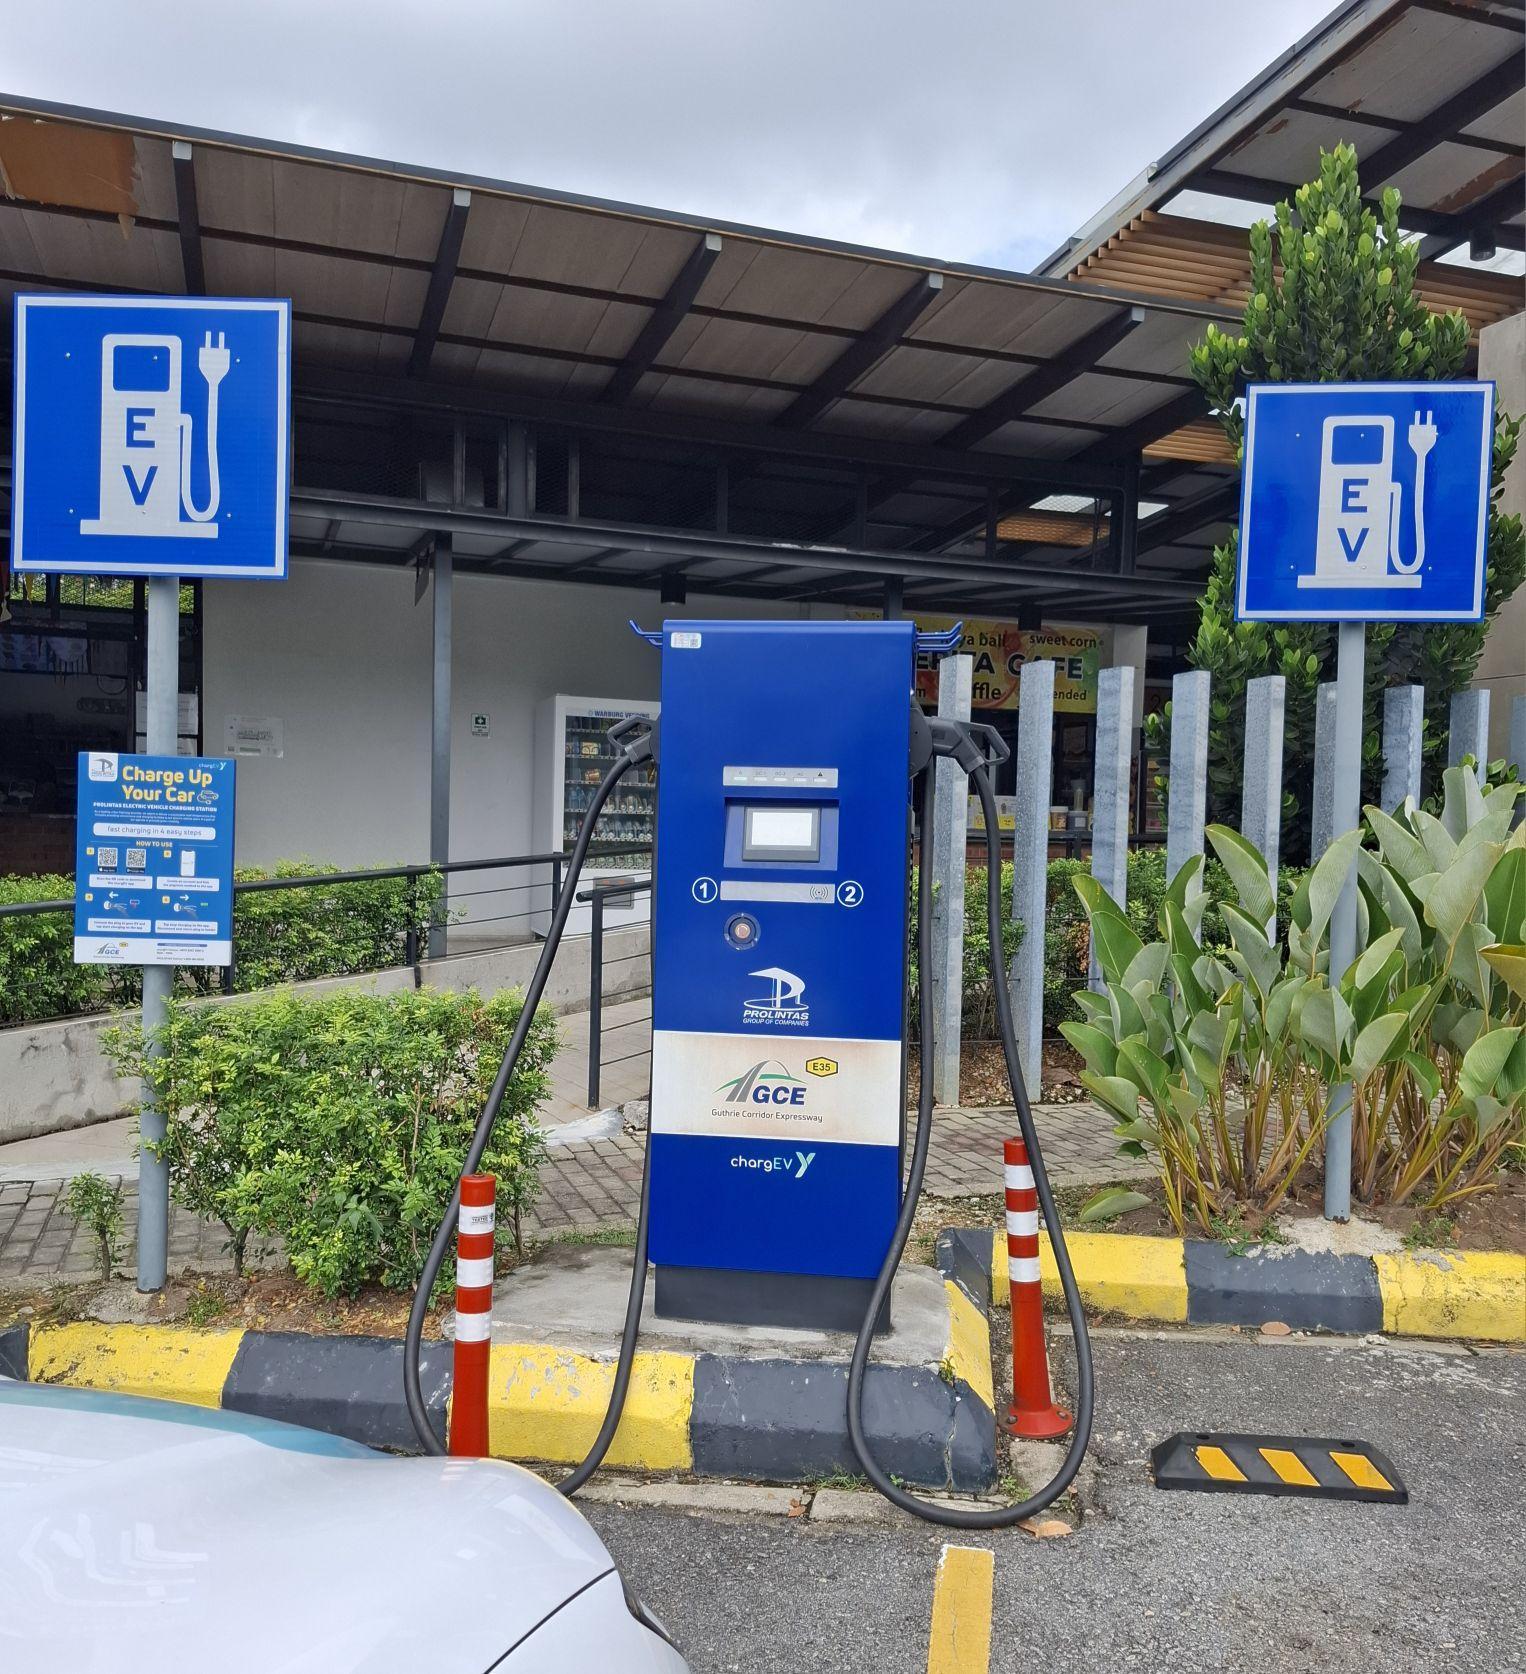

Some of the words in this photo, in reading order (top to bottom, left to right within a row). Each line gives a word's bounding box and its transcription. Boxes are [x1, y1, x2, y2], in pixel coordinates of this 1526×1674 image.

[980, 632, 1005, 647] ball
[1029, 634, 1066, 646] sweet
[1069, 637, 1097, 648] corn
[1008, 653, 1083, 679] CFE
[973, 682, 1002, 700] ffle
[1053, 689, 1087, 700] ended
[122, 765, 184, 786] Charge
[188, 768, 212, 788] Up
[122, 784, 162, 801] Your
[165, 786, 195, 803] Car
[122, 826, 151, 834] charging
[742, 1017, 765, 1025] GROUP
[774, 1019, 810, 1027] COMPANIES
[743, 1009, 810, 1021] PROLINTAS
[812, 1062, 831, 1072] E35
[752, 1085, 807, 1105] GCE
[711, 1108, 740, 1117] Guthrie
[741, 1110, 773, 1119] Corridor
[775, 1112, 823, 1123] Expressway
